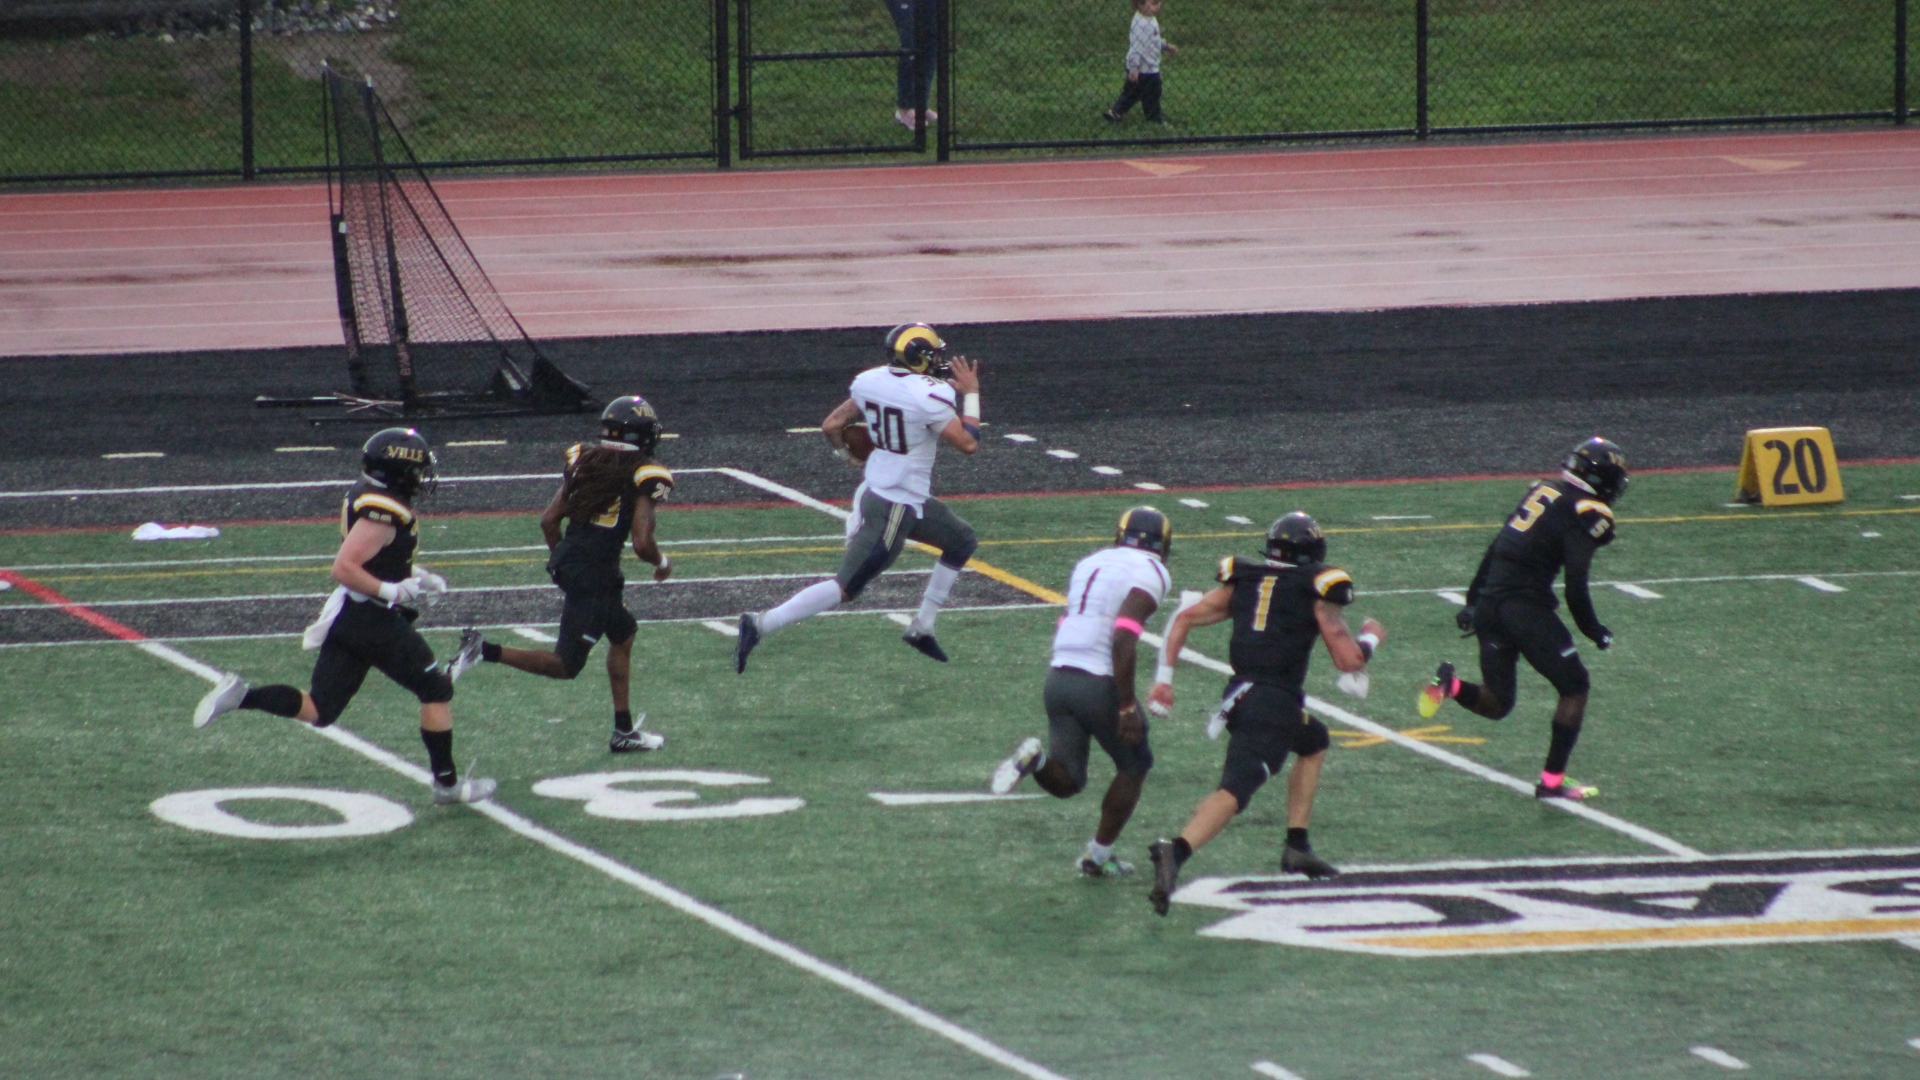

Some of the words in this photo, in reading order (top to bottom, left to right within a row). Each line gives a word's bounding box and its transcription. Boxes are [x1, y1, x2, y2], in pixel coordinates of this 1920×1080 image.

[864, 401, 908, 455] 30
[386, 445, 424, 463] VILLE
[1763, 437, 1827, 495] 20
[1508, 484, 1562, 533] 5
[1077, 567, 1101, 615] 1
[1254, 575, 1278, 631] 1
